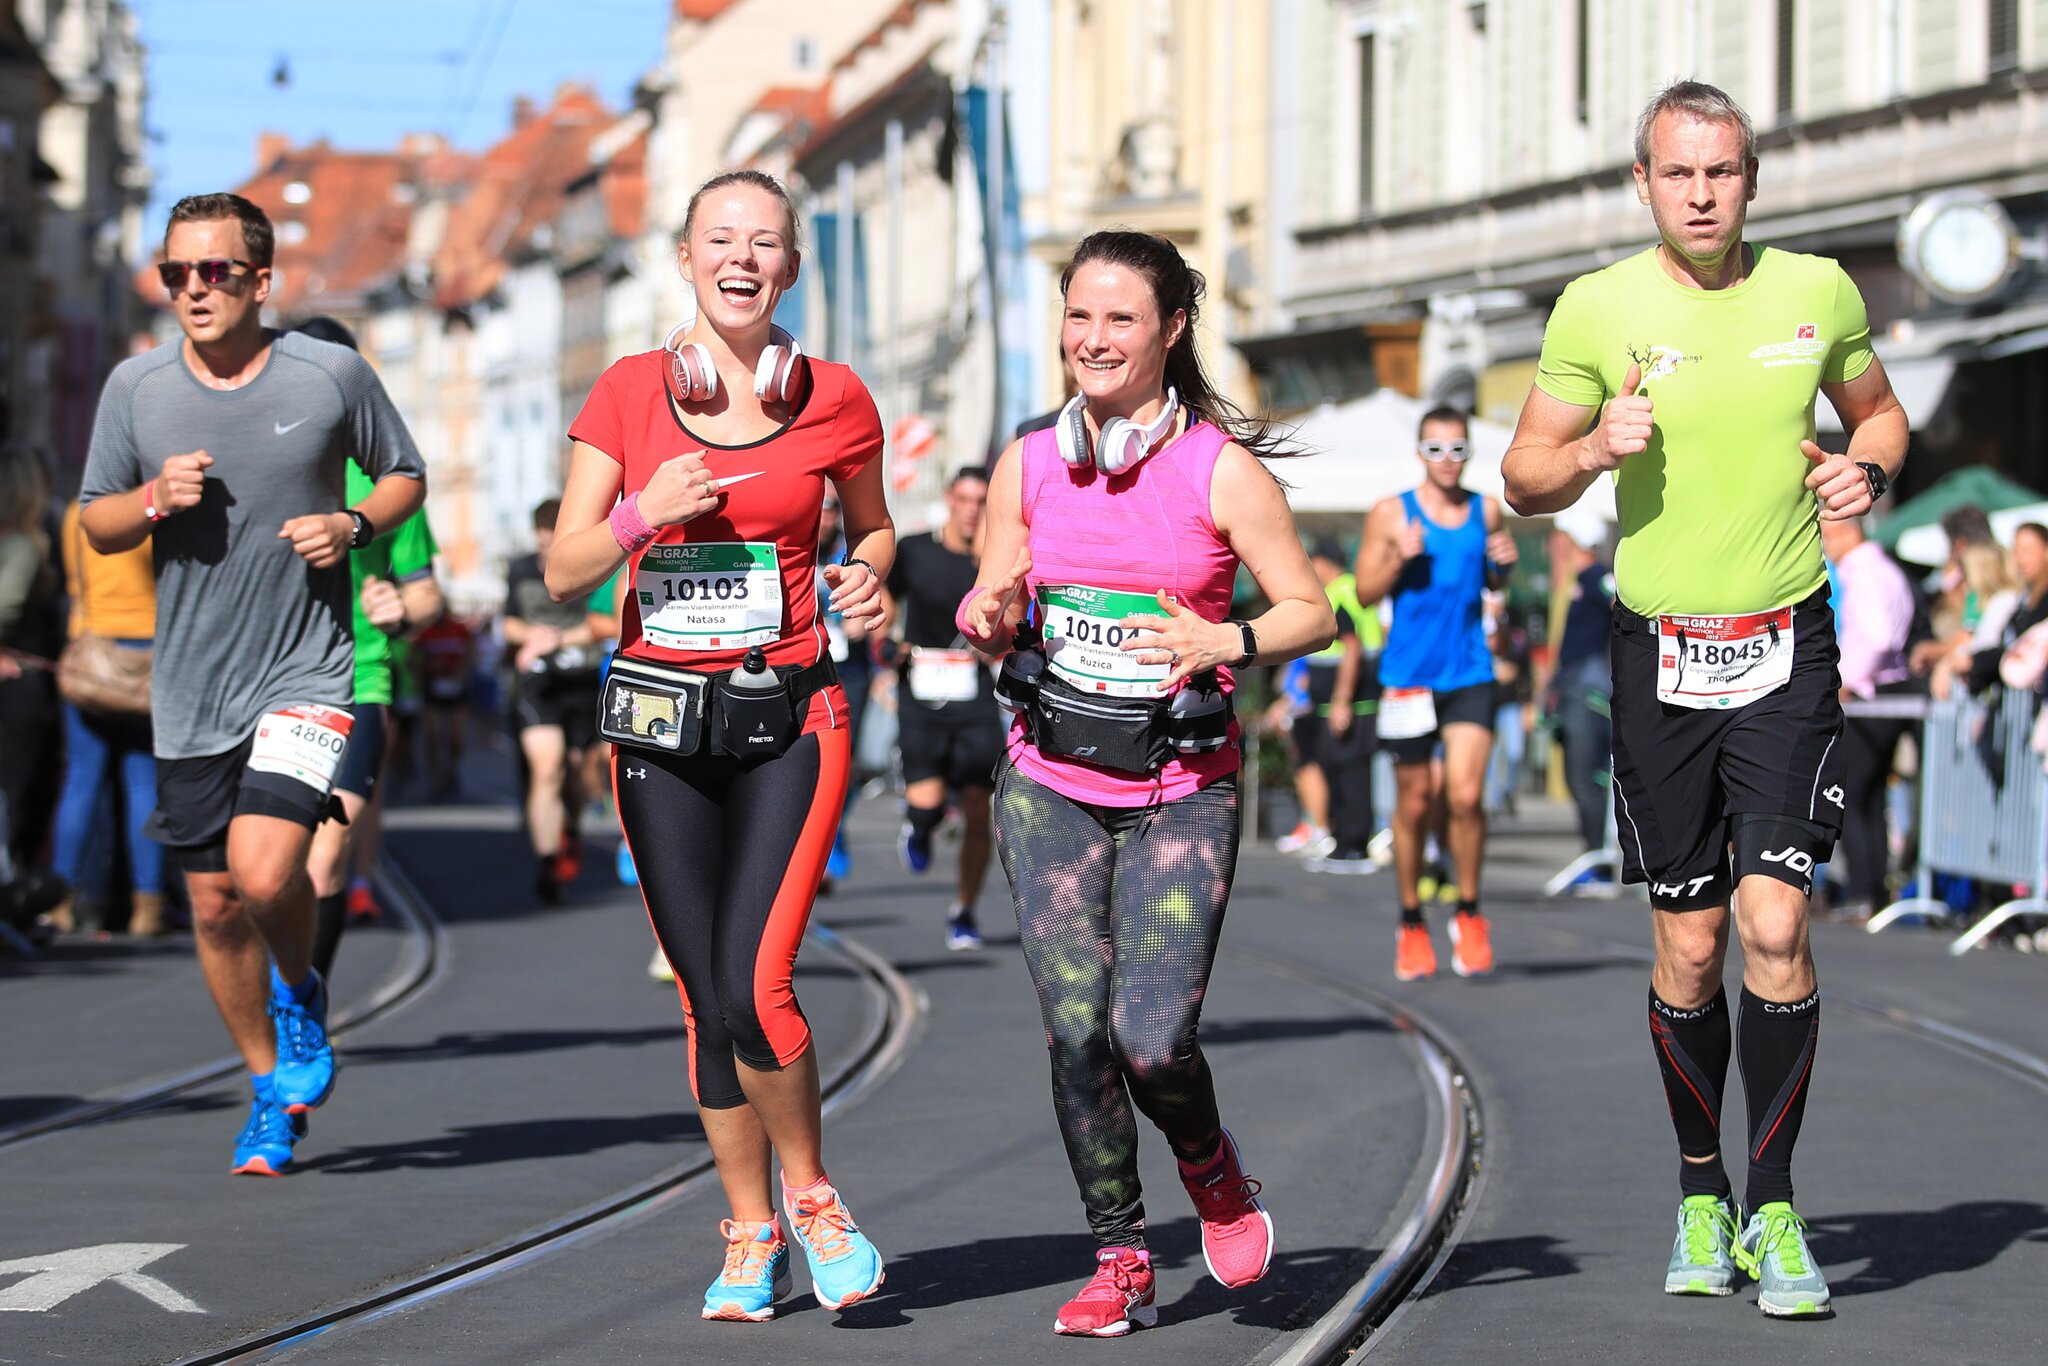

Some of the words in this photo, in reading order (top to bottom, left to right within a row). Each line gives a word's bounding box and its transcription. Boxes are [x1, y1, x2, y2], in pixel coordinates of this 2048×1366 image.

[663, 547, 699, 559] GRAZ
[662, 577, 749, 601] 10103
[1066, 587, 1098, 603] GRAZ
[665, 603, 690, 611] Garmin
[690, 603, 749, 611] Viertelmarathon
[1061, 595, 1087, 607] MARATHON
[687, 615, 726, 624] Natasa
[1690, 618, 1724, 630] GRAZ
[1683, 626, 1715, 635] MARATHON
[1083, 644, 1138, 660] Viertelmarathon
[1689, 639, 1764, 666] 18045
[1080, 655, 1113, 671] Ruzica
[1706, 673, 1744, 685] Thoma
[289, 724, 344, 754] 4860
